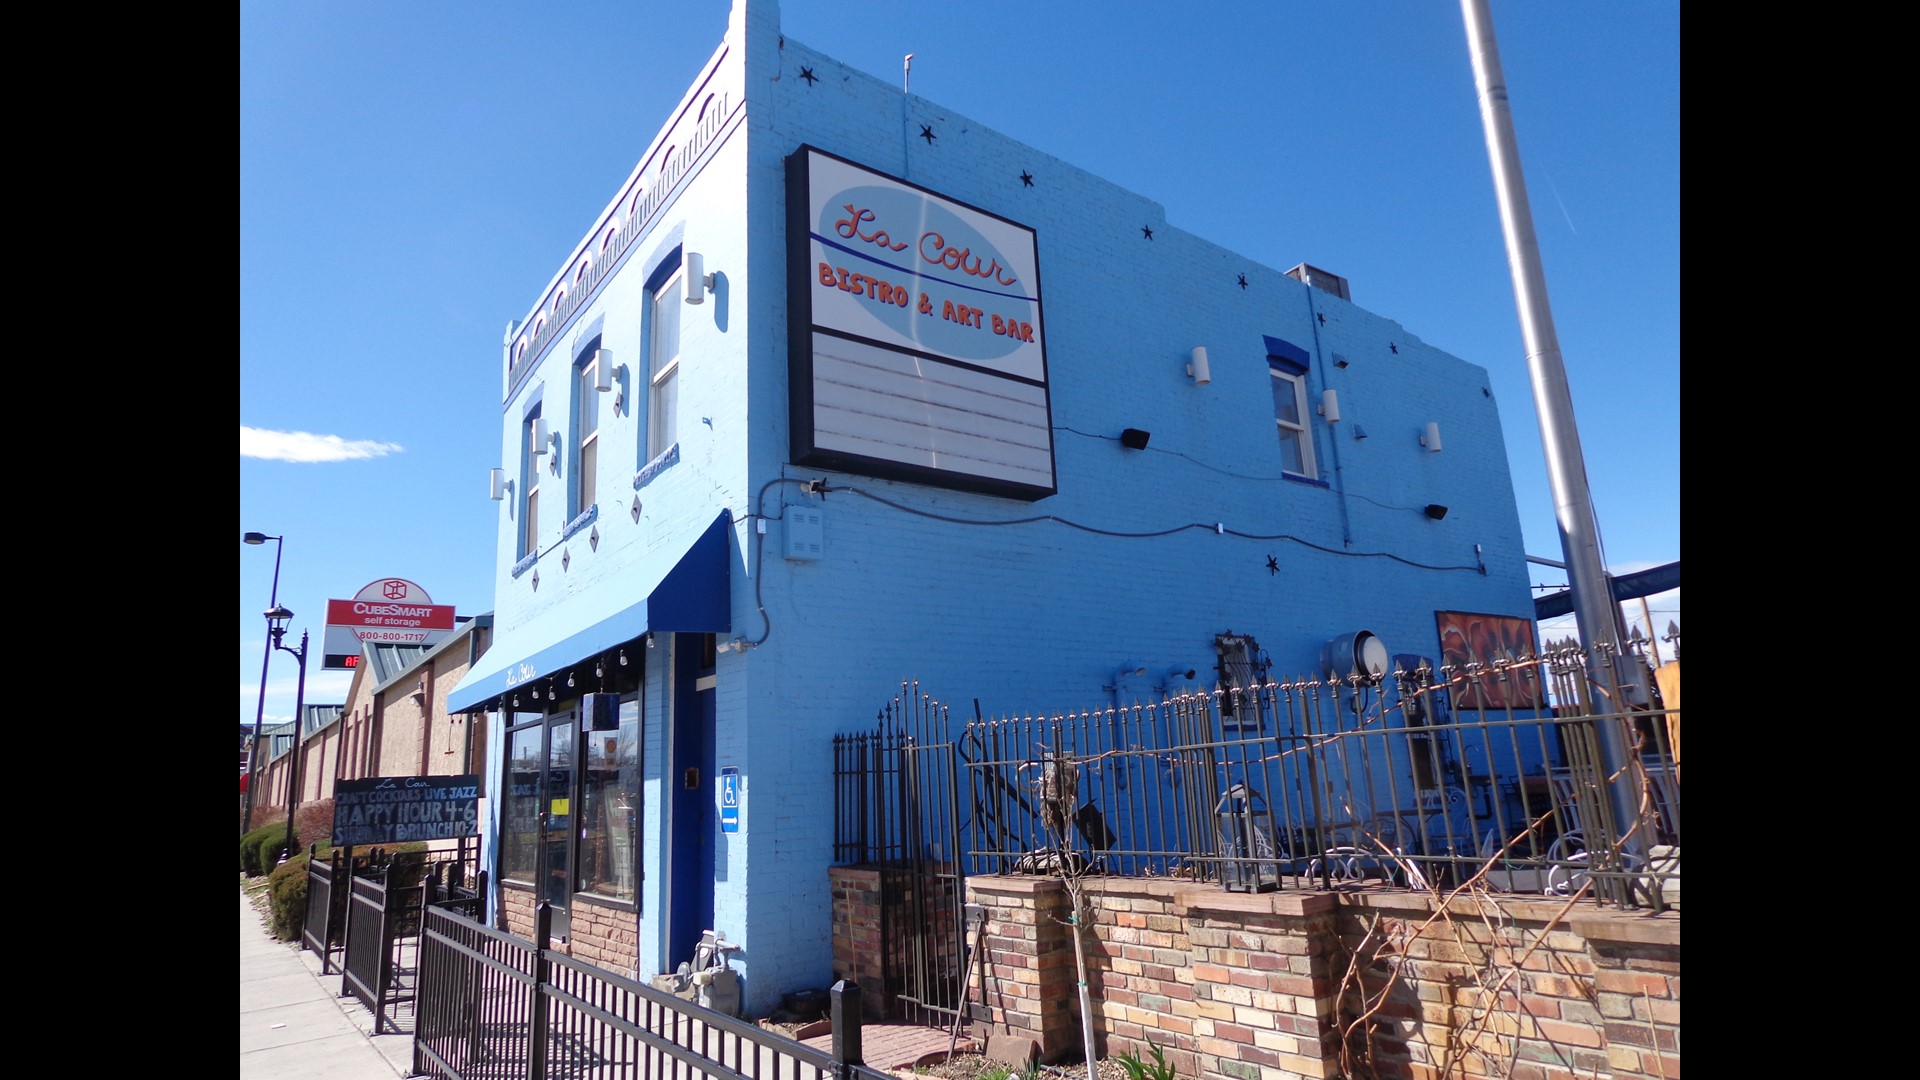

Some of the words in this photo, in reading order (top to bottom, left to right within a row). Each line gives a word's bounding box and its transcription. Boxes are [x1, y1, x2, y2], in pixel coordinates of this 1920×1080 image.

[835, 203, 908, 252] La
[919, 231, 1017, 286] Cour
[818, 262, 908, 307] BISTRO
[917, 292, 933, 316] &
[942, 300, 983, 329] ART
[991, 313, 1034, 343] BAR
[364, 616, 383, 624] self
[384, 616, 421, 626] storage
[360, 631, 424, 641] 800-800-1717
[424, 787, 447, 800] LIVE
[448, 786, 478, 799] JAZZ
[336, 803, 396, 826] HAPPY
[398, 801, 442, 823] HOUR
[445, 800, 476, 822] 4-6
[396, 821, 454, 840] BRUNCH
